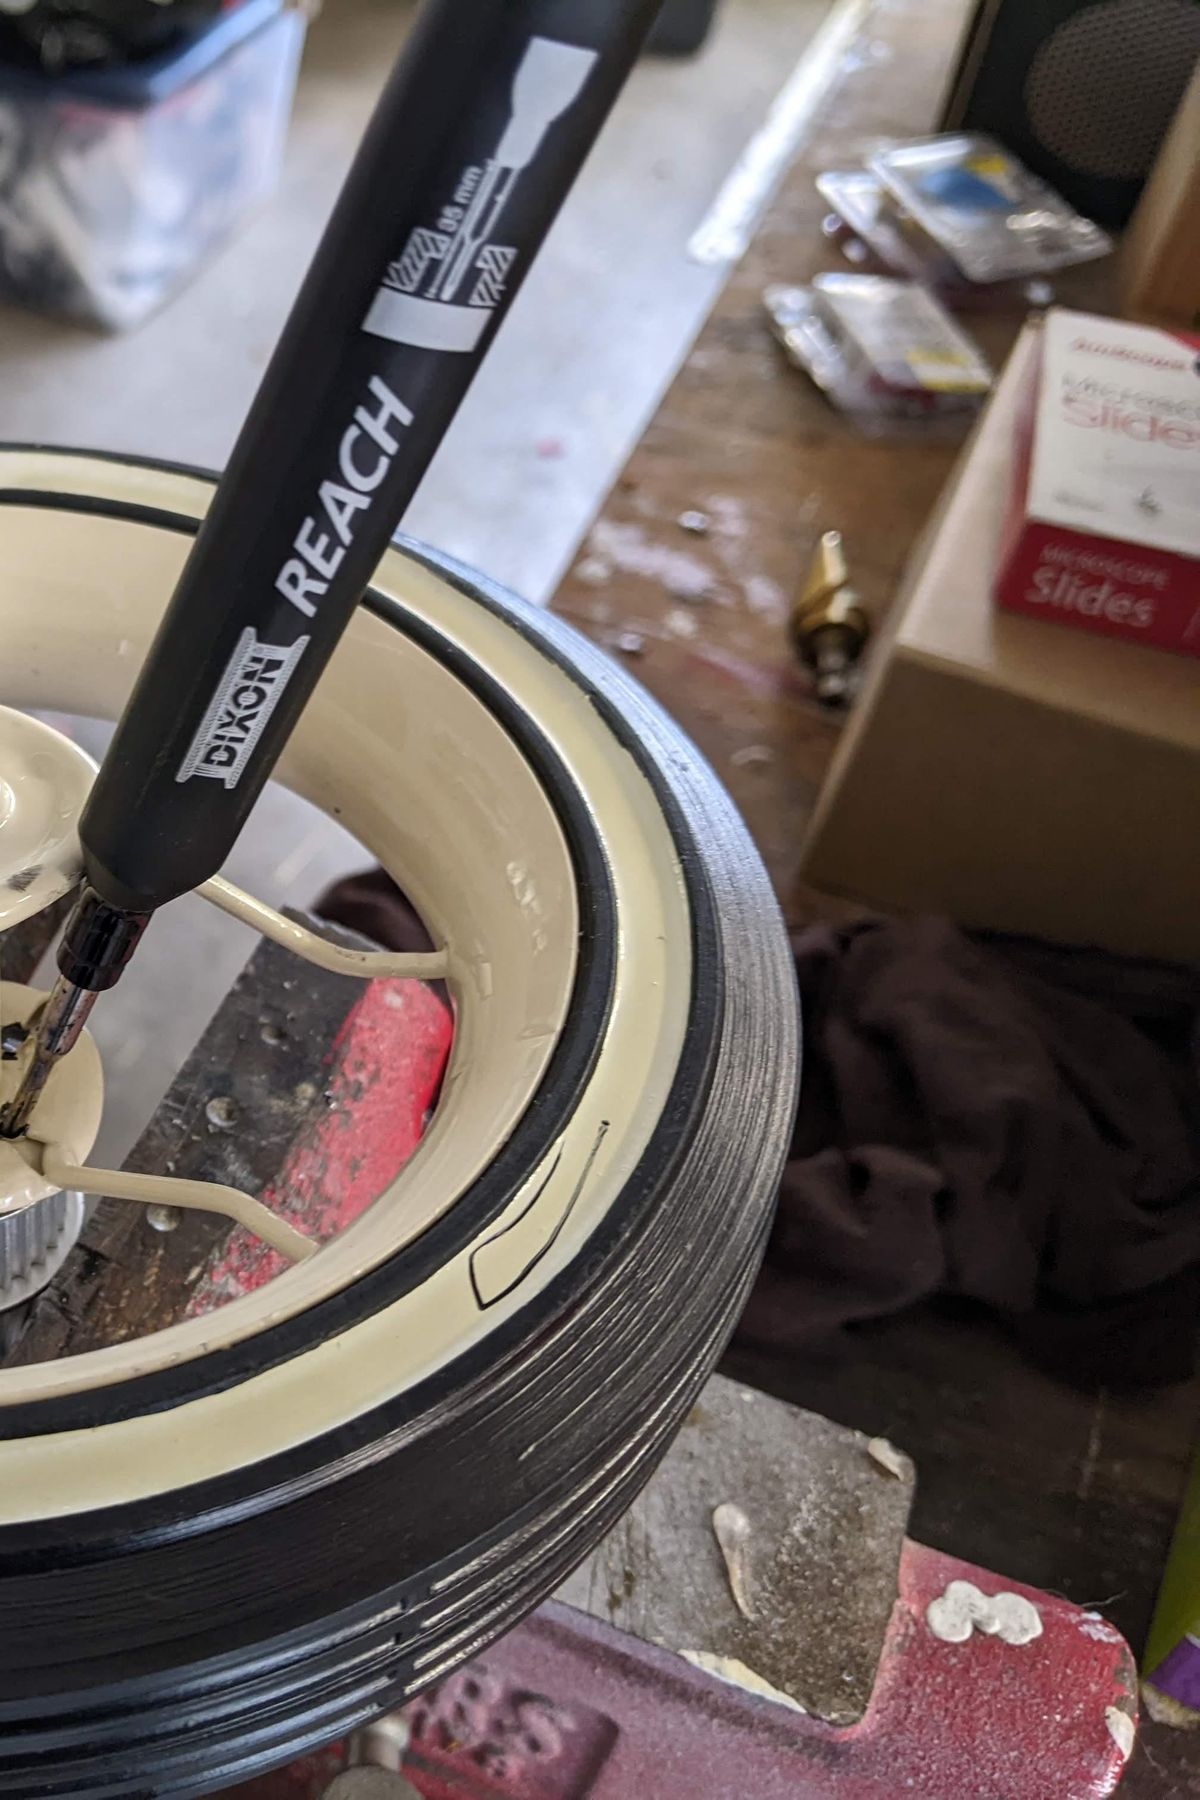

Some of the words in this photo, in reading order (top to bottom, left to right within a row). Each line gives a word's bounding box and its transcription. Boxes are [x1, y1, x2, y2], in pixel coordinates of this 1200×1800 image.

[452, 165, 484, 206] mm
[274, 375, 415, 619] REACH
[1024, 565, 1154, 629] Slides
[201, 654, 287, 770] DIXON
